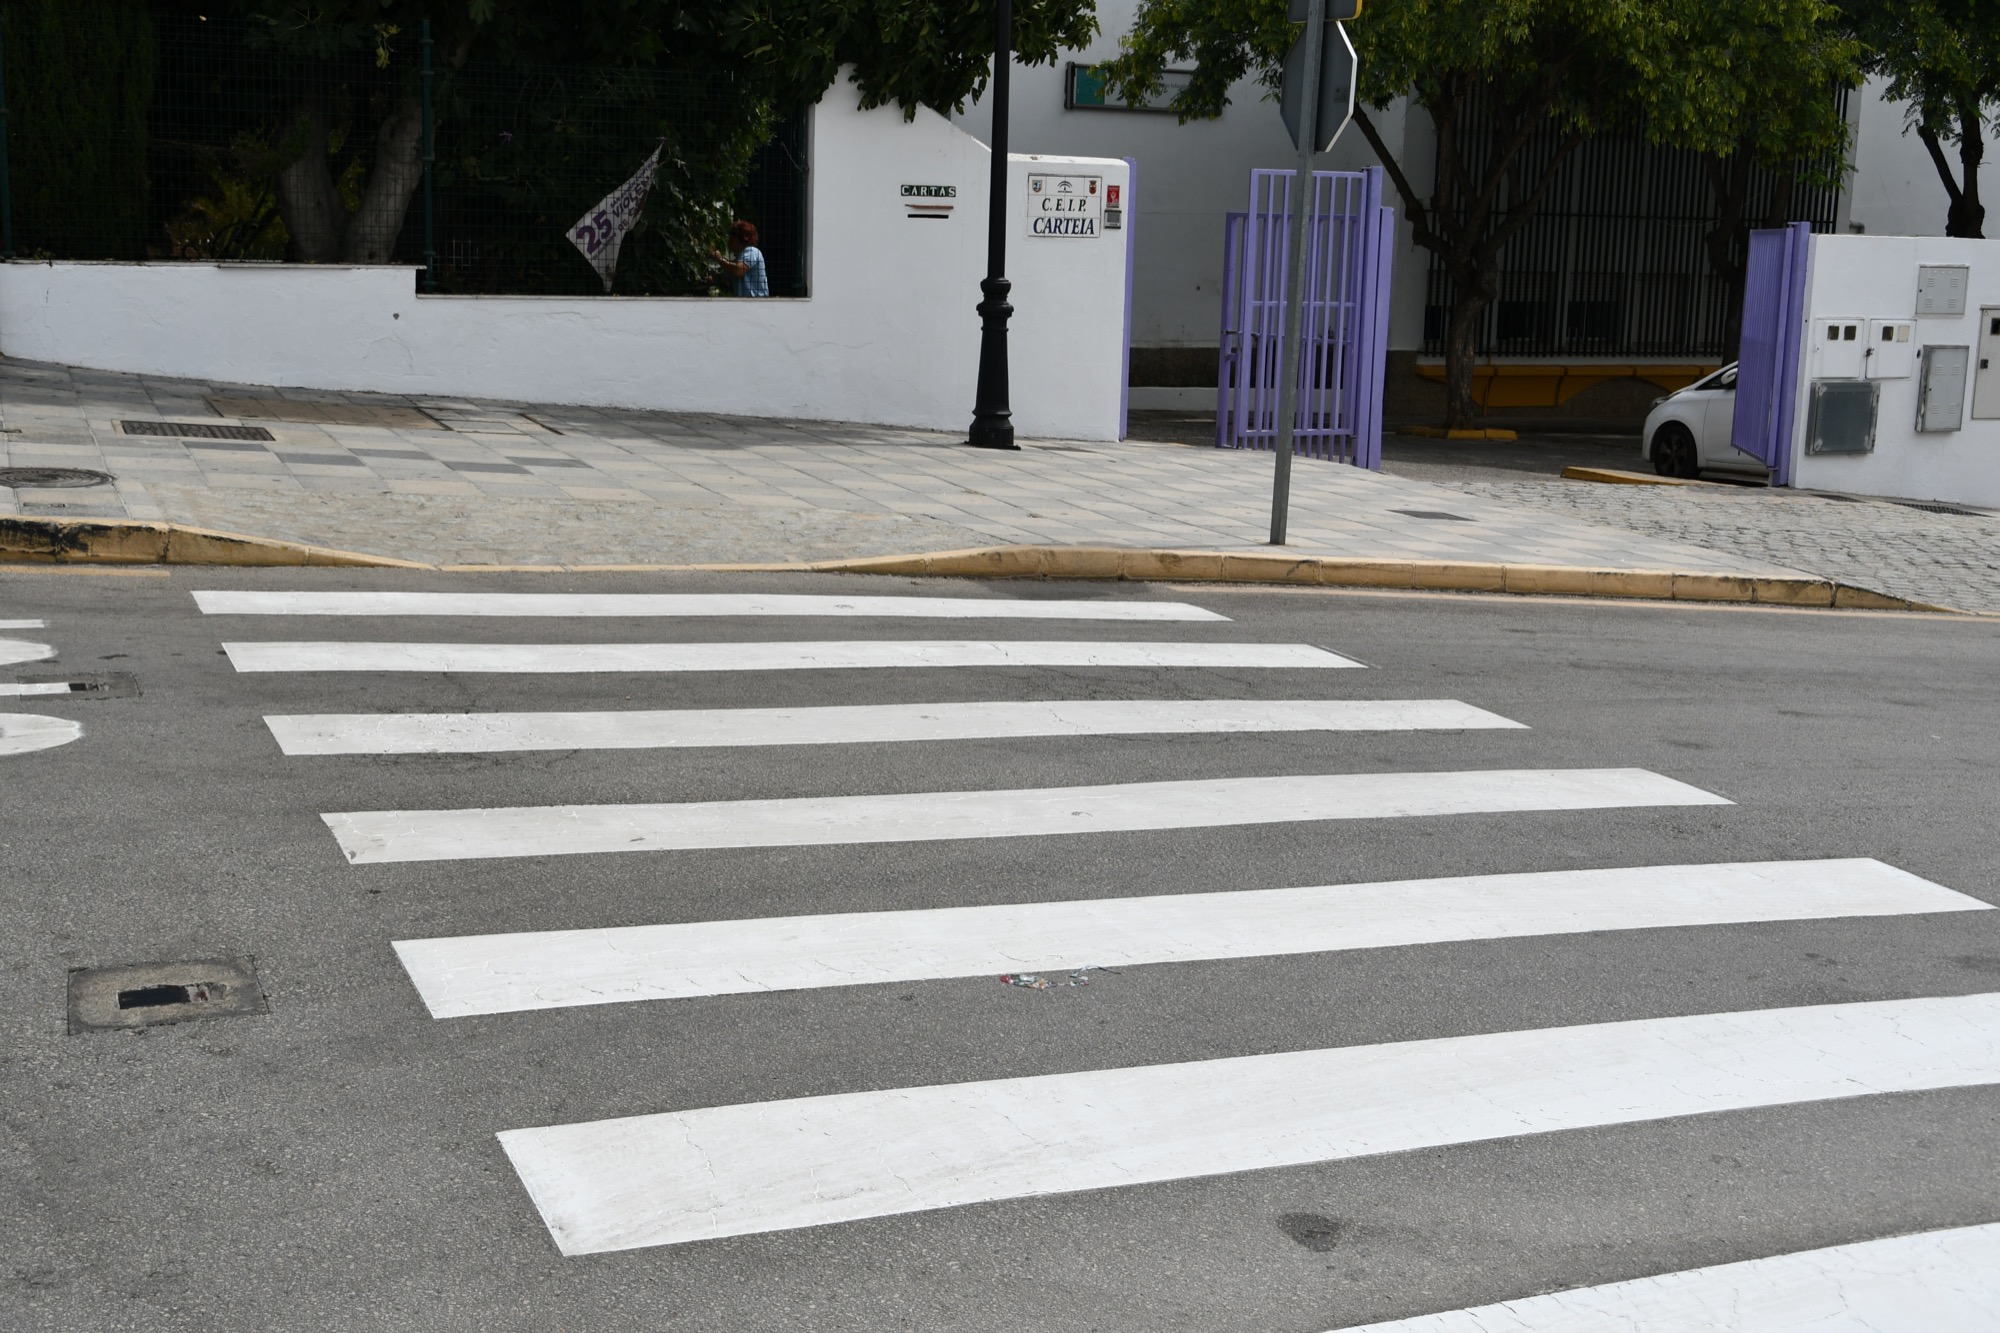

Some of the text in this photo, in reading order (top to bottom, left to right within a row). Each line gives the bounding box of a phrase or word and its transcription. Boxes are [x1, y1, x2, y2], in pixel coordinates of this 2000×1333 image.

[901, 185, 956, 197] CARTAS
[576, 209, 612, 254] 25
[1033, 217, 1095, 236] CARTEIA
